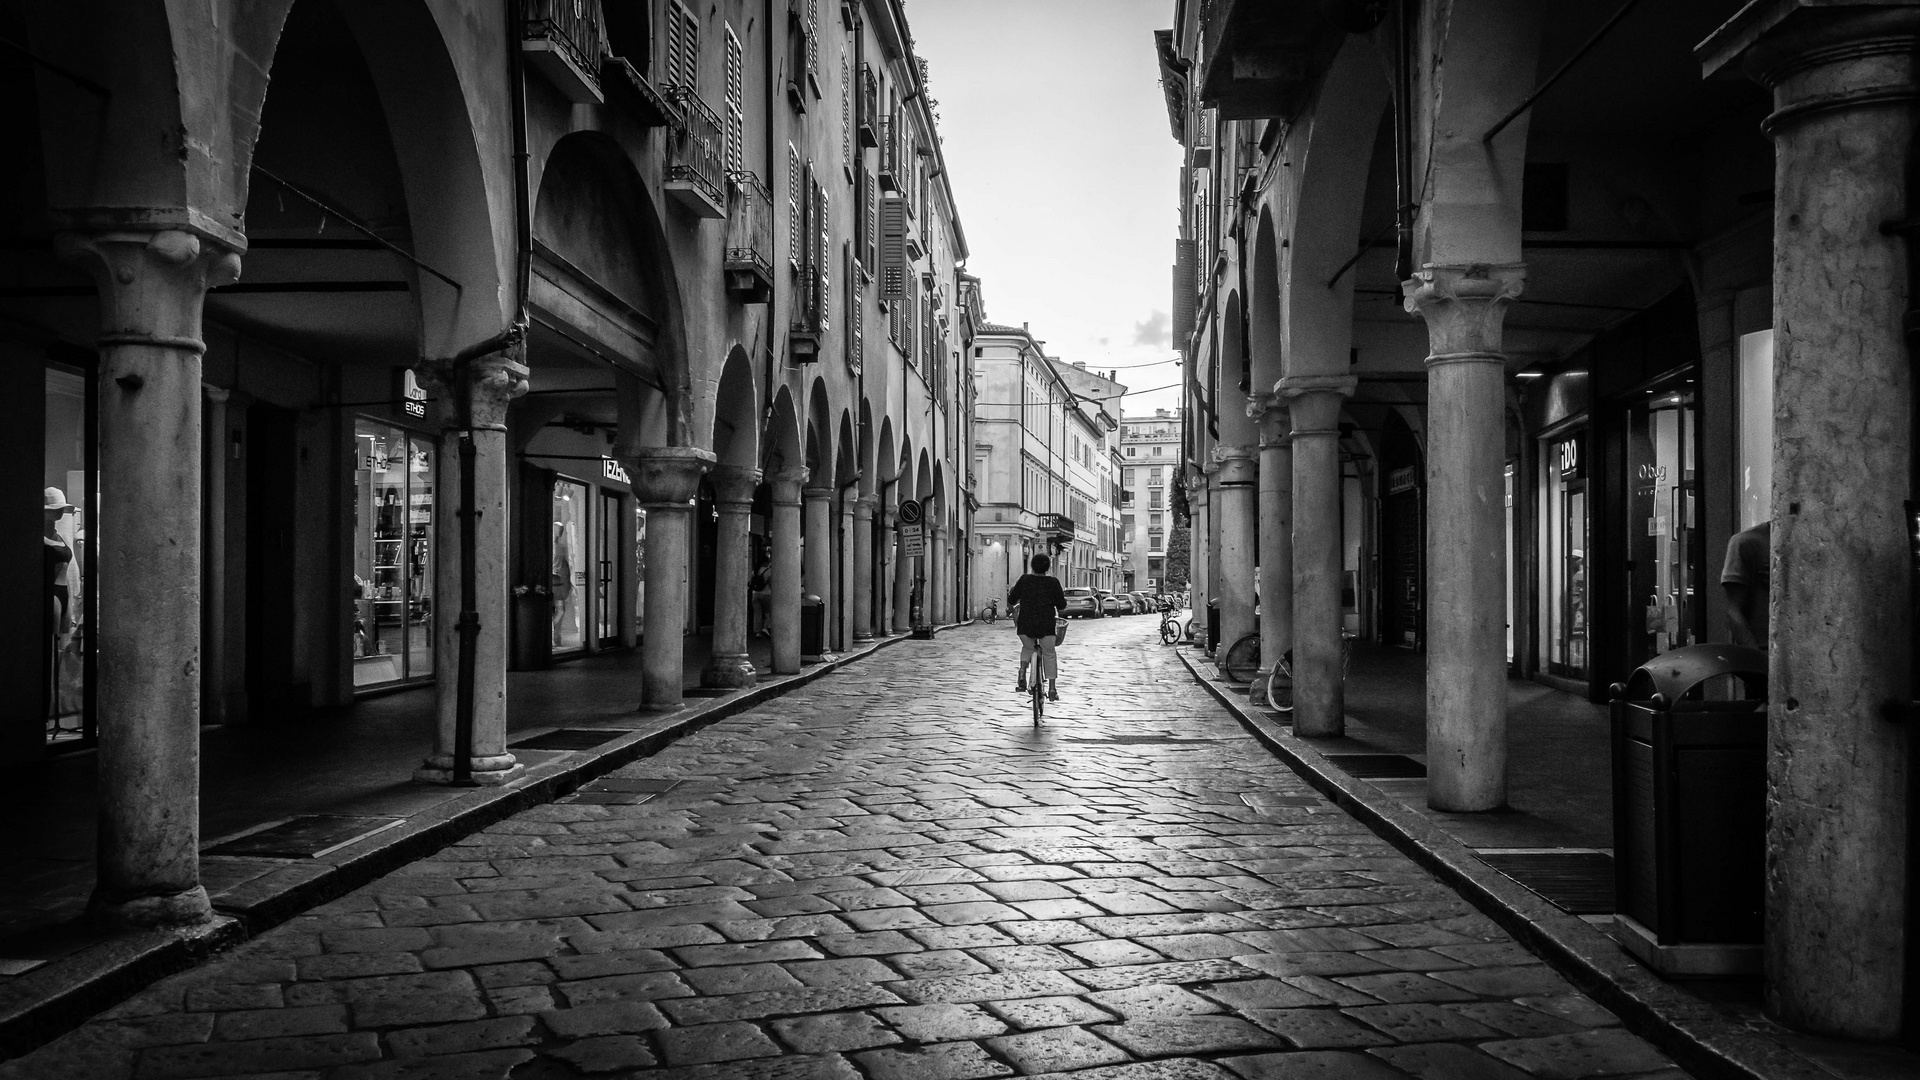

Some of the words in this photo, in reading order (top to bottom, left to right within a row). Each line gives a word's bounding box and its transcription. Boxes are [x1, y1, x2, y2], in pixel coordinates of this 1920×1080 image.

[405, 401, 425, 415] ETHOS
[1561, 439, 1577, 470] iDO
[366, 456, 392, 471] ETHOS
[1638, 464, 1647, 480] O
[1648, 463, 1667, 481] bag
